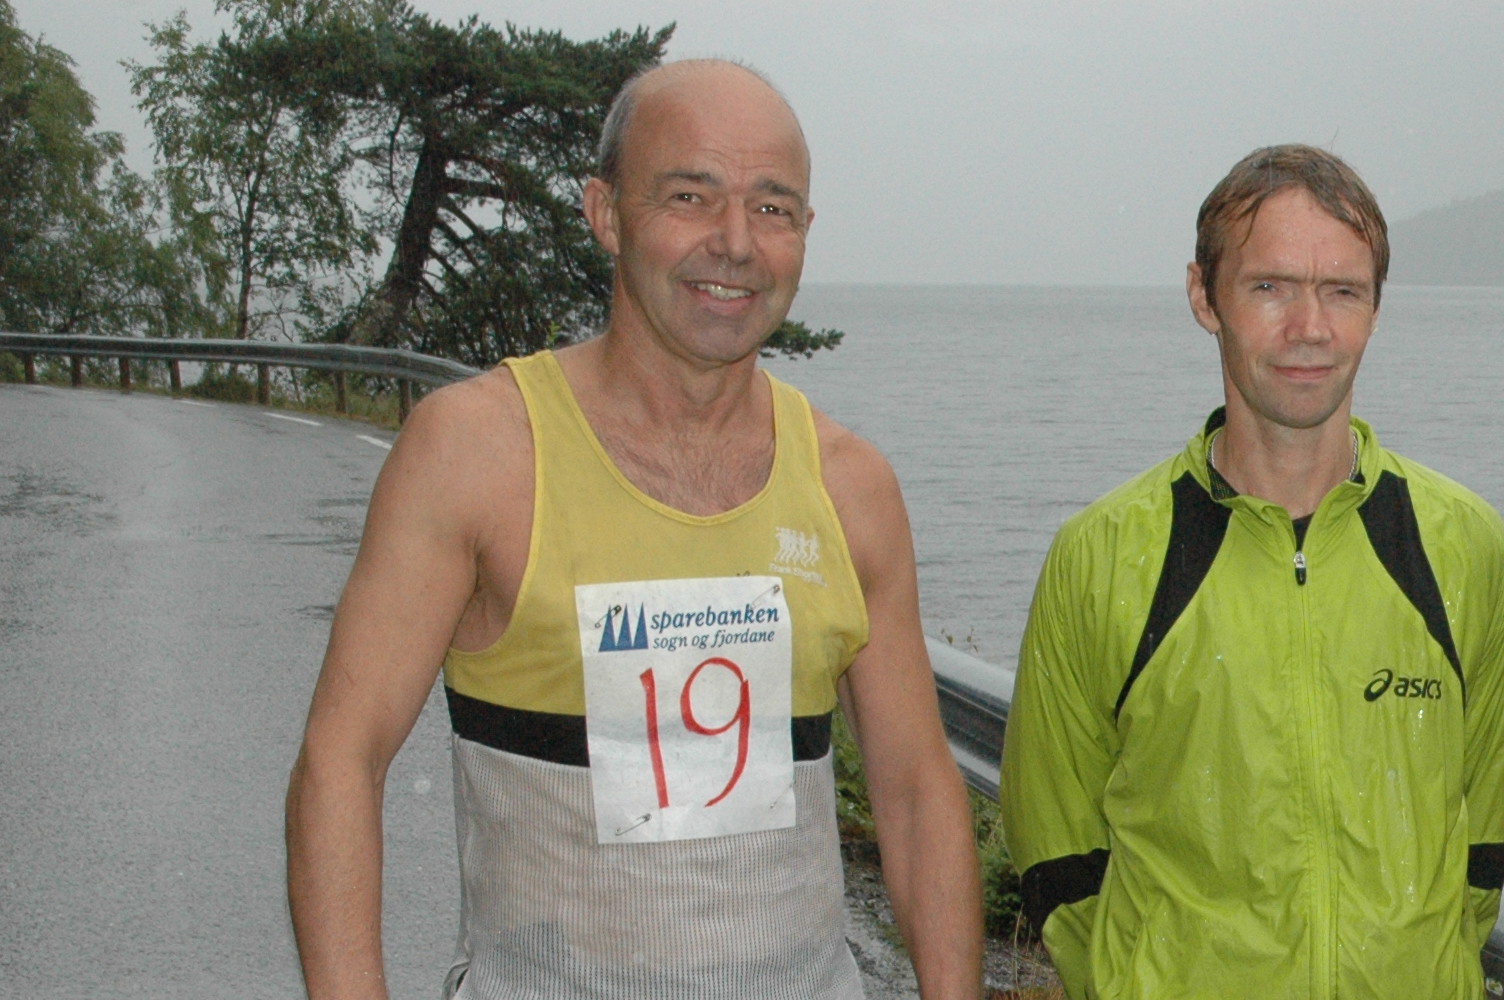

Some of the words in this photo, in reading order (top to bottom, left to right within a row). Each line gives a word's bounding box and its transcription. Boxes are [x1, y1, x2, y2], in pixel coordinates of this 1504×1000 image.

[650, 603, 779, 634] sparebanken
[653, 635, 688, 652] sogn
[691, 634, 709, 650] og
[711, 628, 775, 648] fjordane
[1394, 677, 1442, 700] asics
[639, 656, 750, 809] 19
